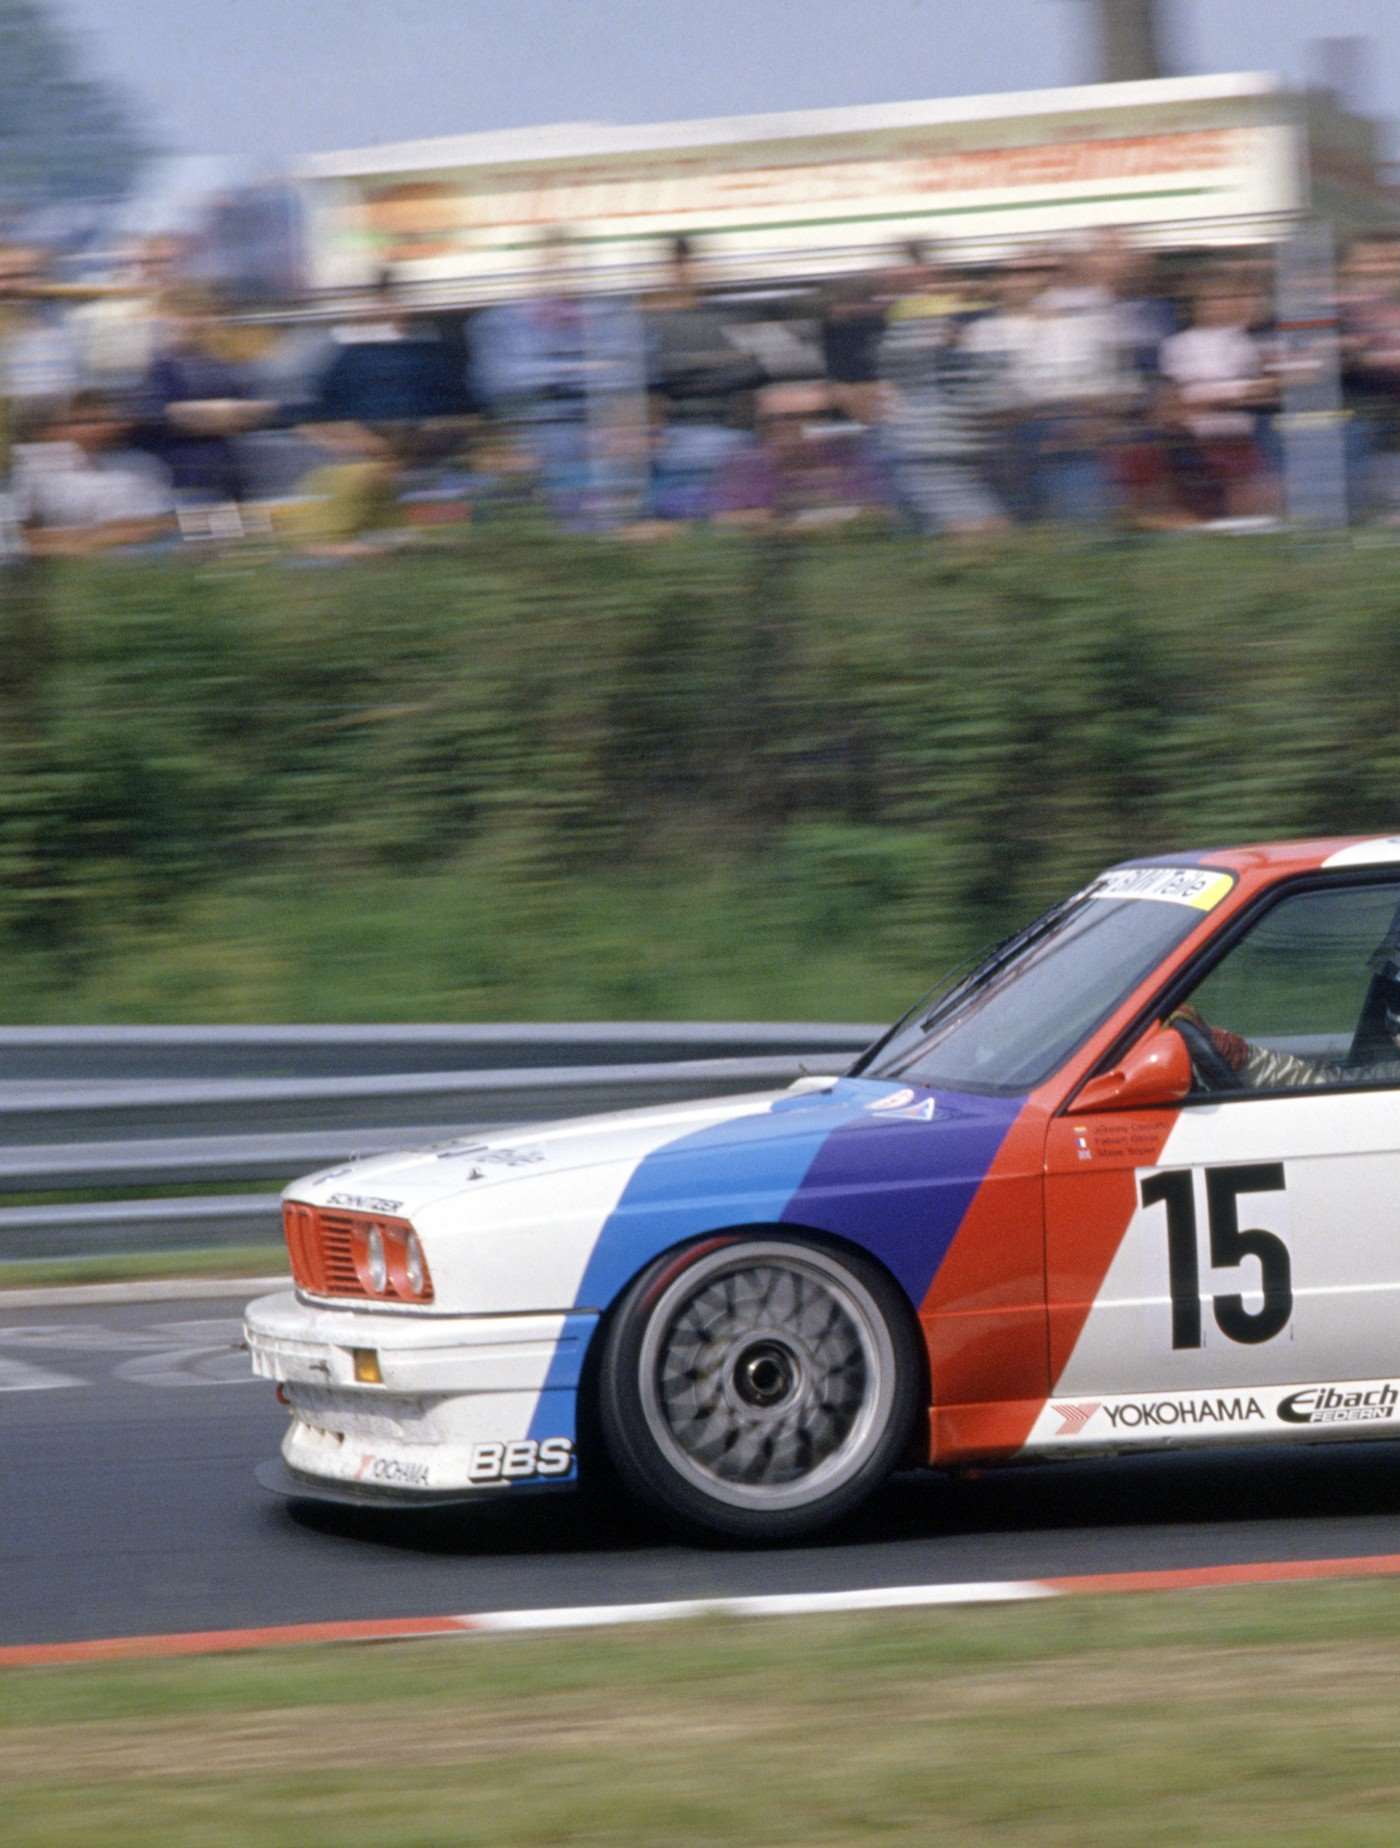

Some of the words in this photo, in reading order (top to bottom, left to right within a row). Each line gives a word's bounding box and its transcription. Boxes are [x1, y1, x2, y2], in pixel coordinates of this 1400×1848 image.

[1140, 1161, 1293, 1351] 15
[1103, 1397, 1265, 1428] YOKOHAMA
[1276, 1384, 1400, 1423] Eibach
[1309, 1406, 1393, 1424] FEDERN
[468, 1437, 574, 1483] BBS
